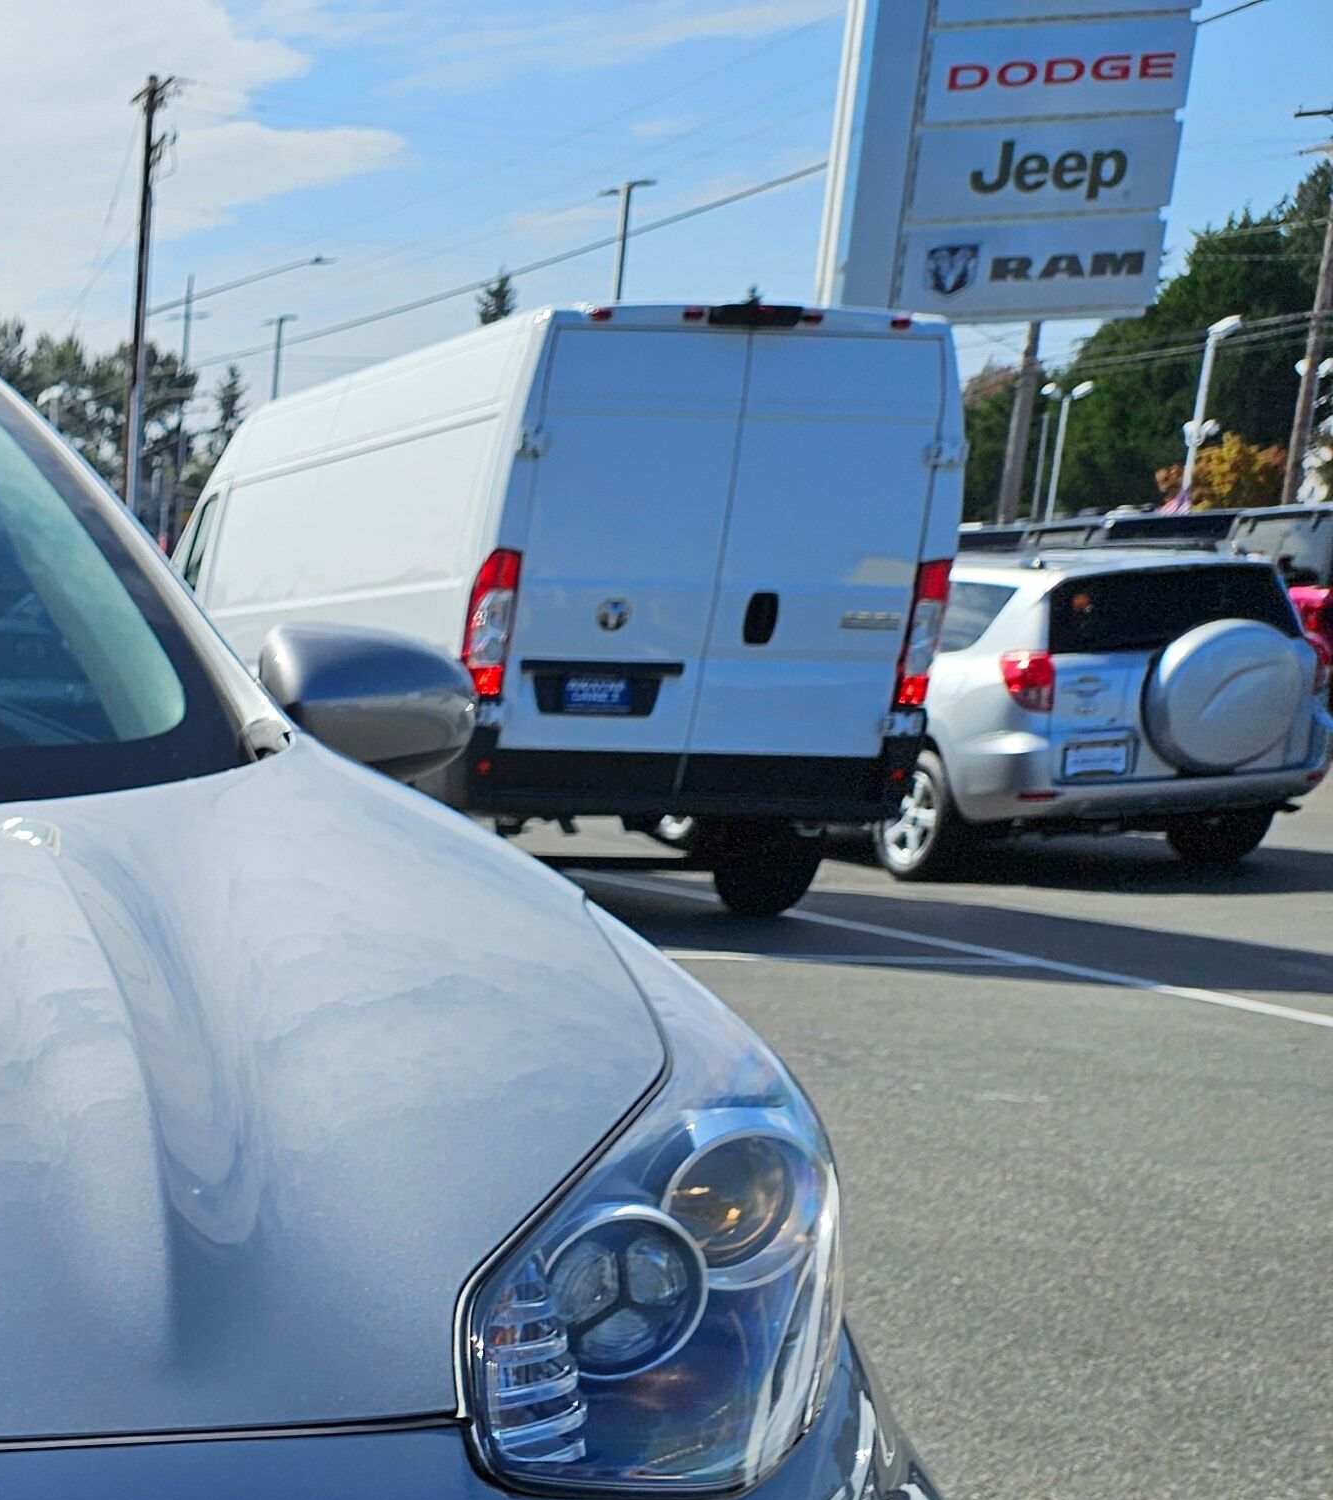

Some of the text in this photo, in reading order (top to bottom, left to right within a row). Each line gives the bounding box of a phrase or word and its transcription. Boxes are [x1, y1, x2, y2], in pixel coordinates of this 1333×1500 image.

[947, 52, 1176, 92] DODGE
[969, 139, 1128, 201] Jeep
[988, 251, 1145, 283] RAM
